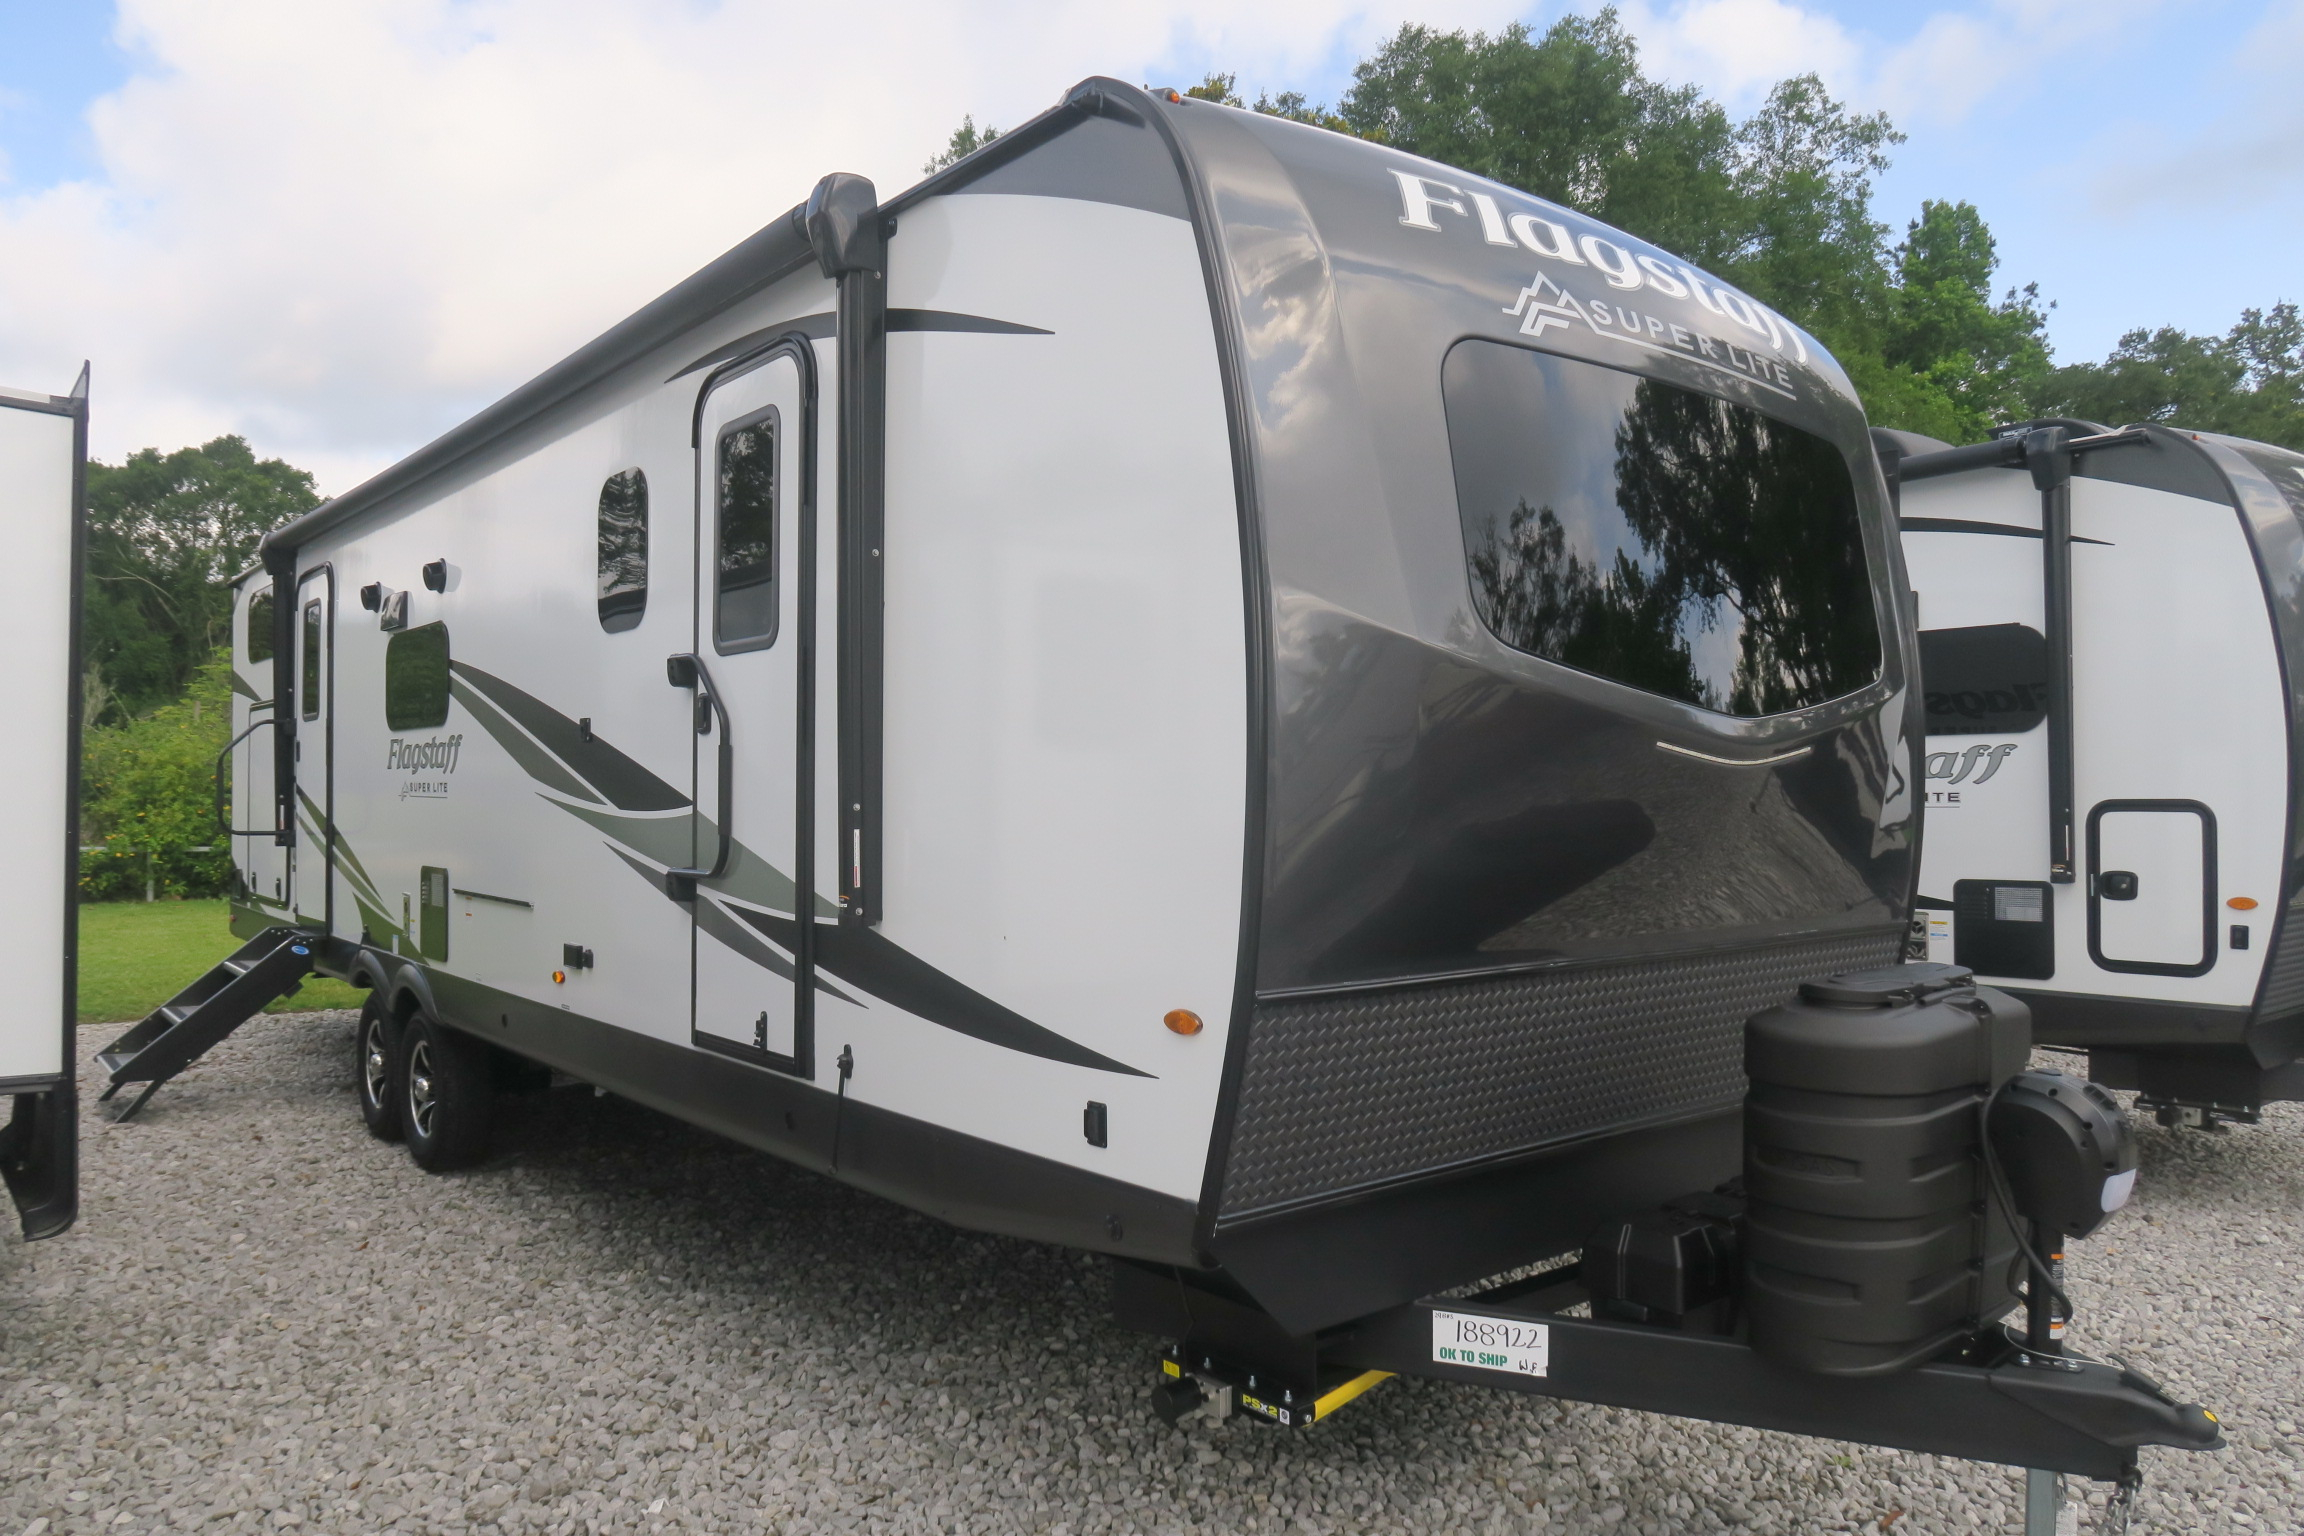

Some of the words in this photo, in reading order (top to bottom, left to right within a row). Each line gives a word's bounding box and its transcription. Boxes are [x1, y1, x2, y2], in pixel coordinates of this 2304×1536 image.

[1386, 168, 1808, 366] Flagstaff
[1592, 299, 1719, 359] SUPER
[1729, 348, 1794, 390] LITE
[387, 734, 463, 775] Flagstaff
[1925, 743, 2018, 785] aff
[409, 782, 431, 793] SUPER
[432, 782, 448, 793] LITE
[1924, 792, 1960, 803] ITE
[1456, 1320, 1542, 1349] 188922
[1439, 1346, 1457, 1360] OK
[1459, 1349, 1475, 1363] TO
[1478, 1352, 1508, 1366] SHIP
